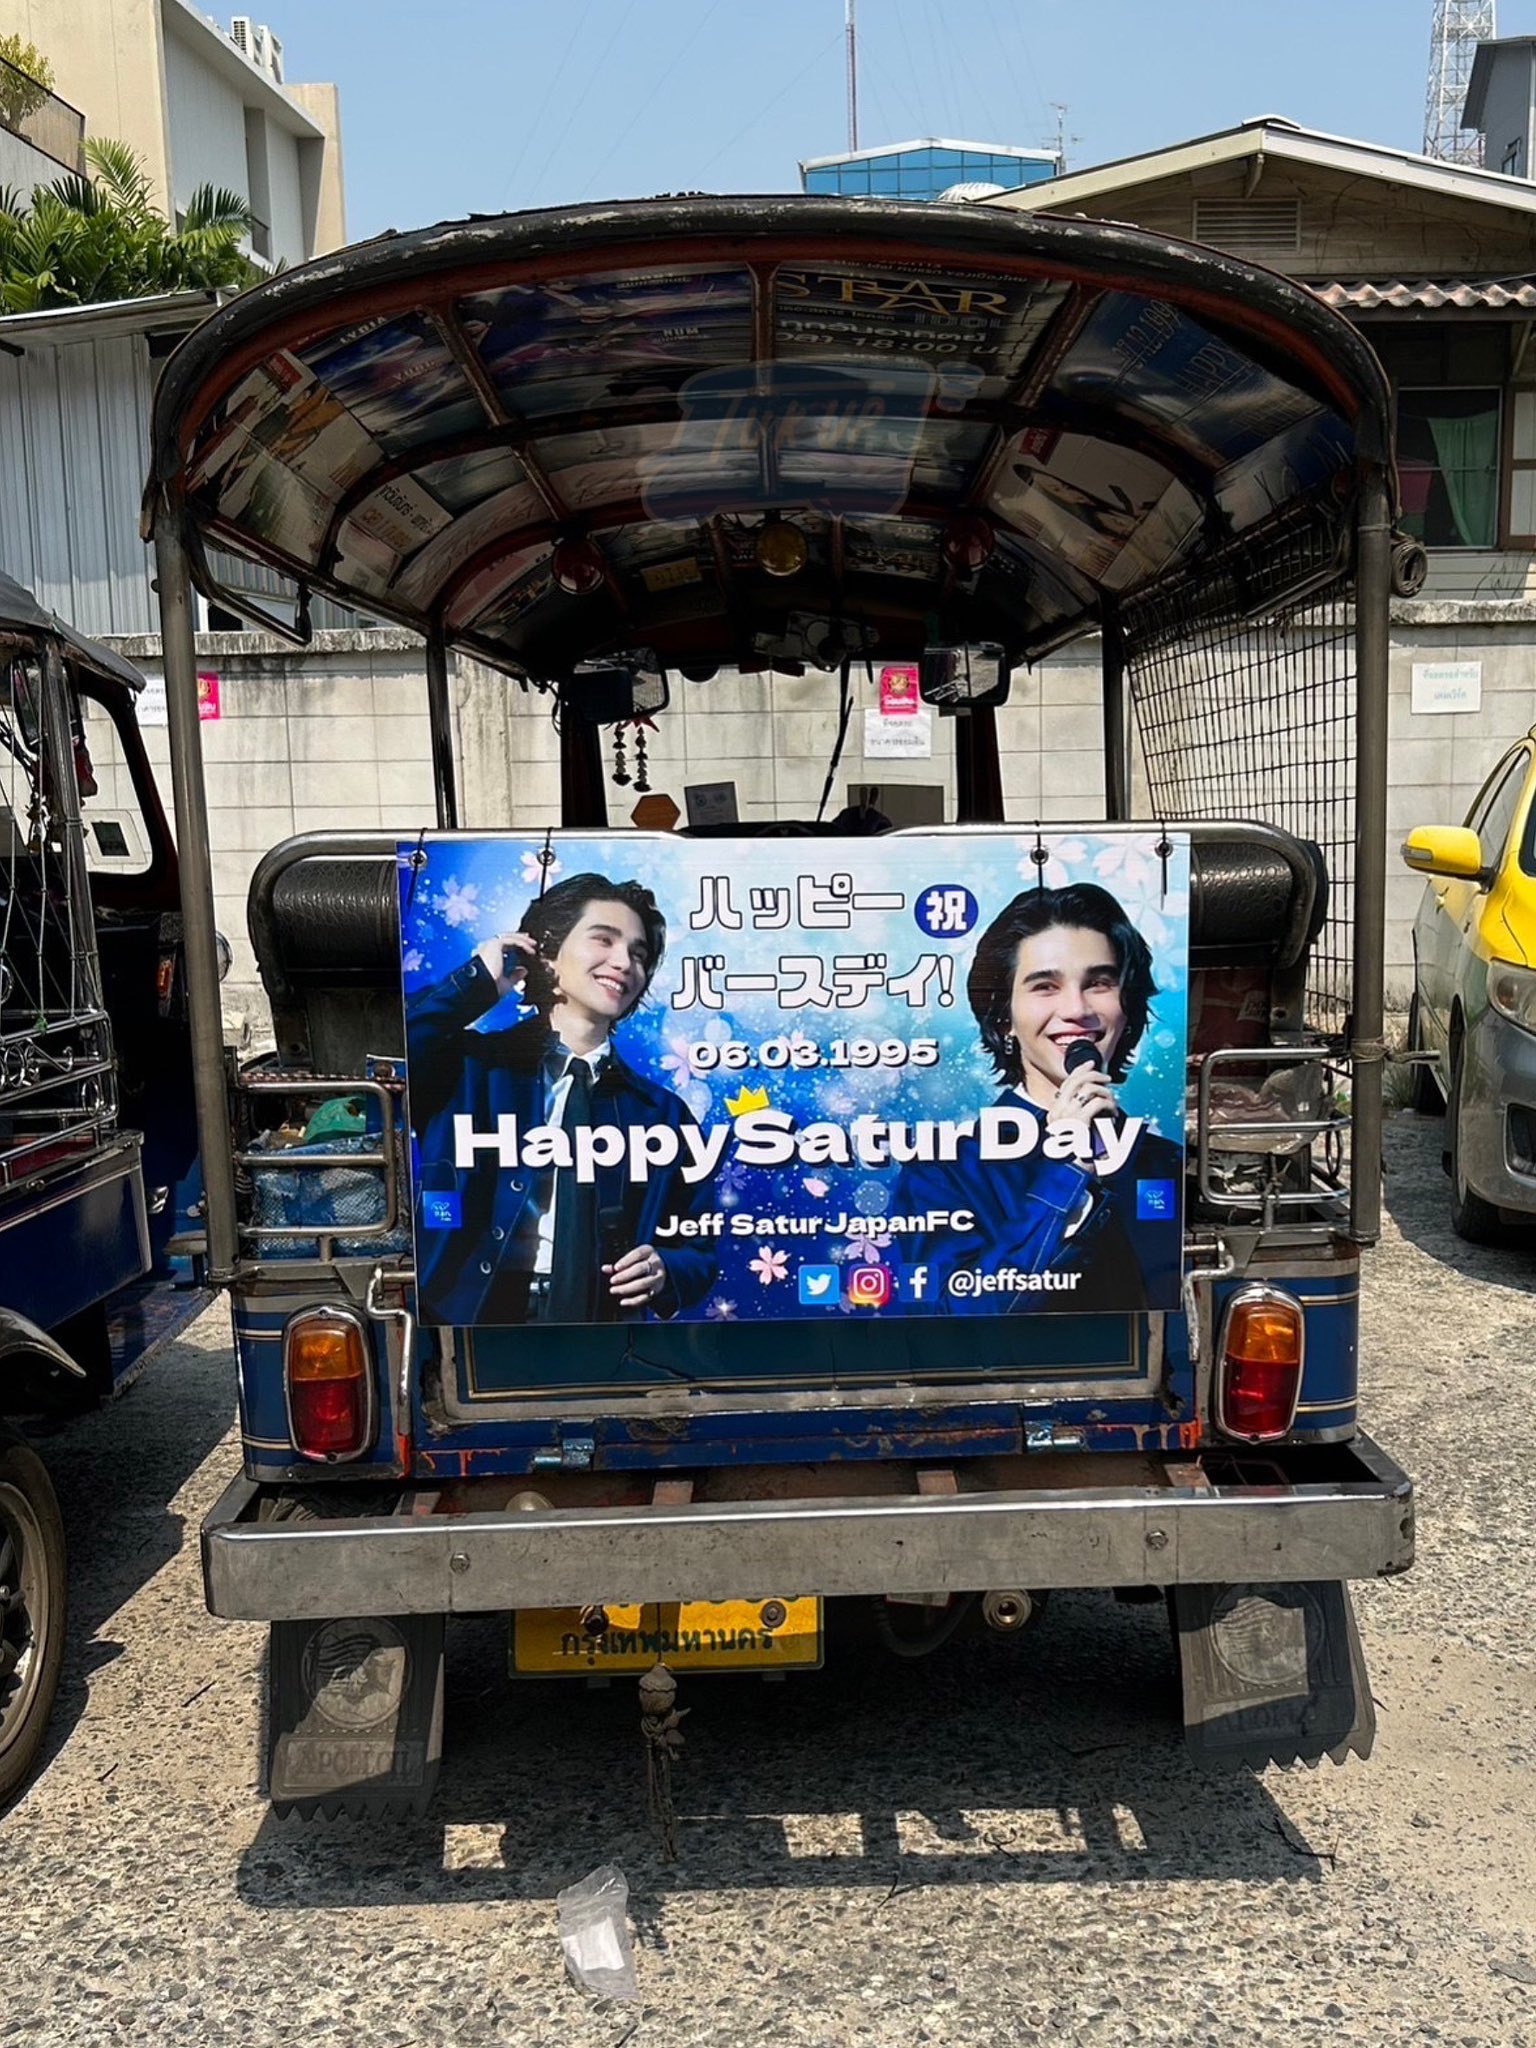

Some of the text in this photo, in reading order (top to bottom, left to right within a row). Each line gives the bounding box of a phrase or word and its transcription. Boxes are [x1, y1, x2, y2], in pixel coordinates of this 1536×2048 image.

[776, 272, 1016, 316] STAR
[854, 336, 958, 354] 18:00
[689, 873, 968, 934] ハッピー 祝
[691, 1039, 940, 1072] 06.03.1995
[453, 1104, 1148, 1185] HappySaturDay
[655, 1208, 975, 1241] Jeff Satur JapanFC
[948, 1267, 1083, 1298] @jeffsatur
[562, 1626, 774, 1666] กรุงเทพมหานคร
